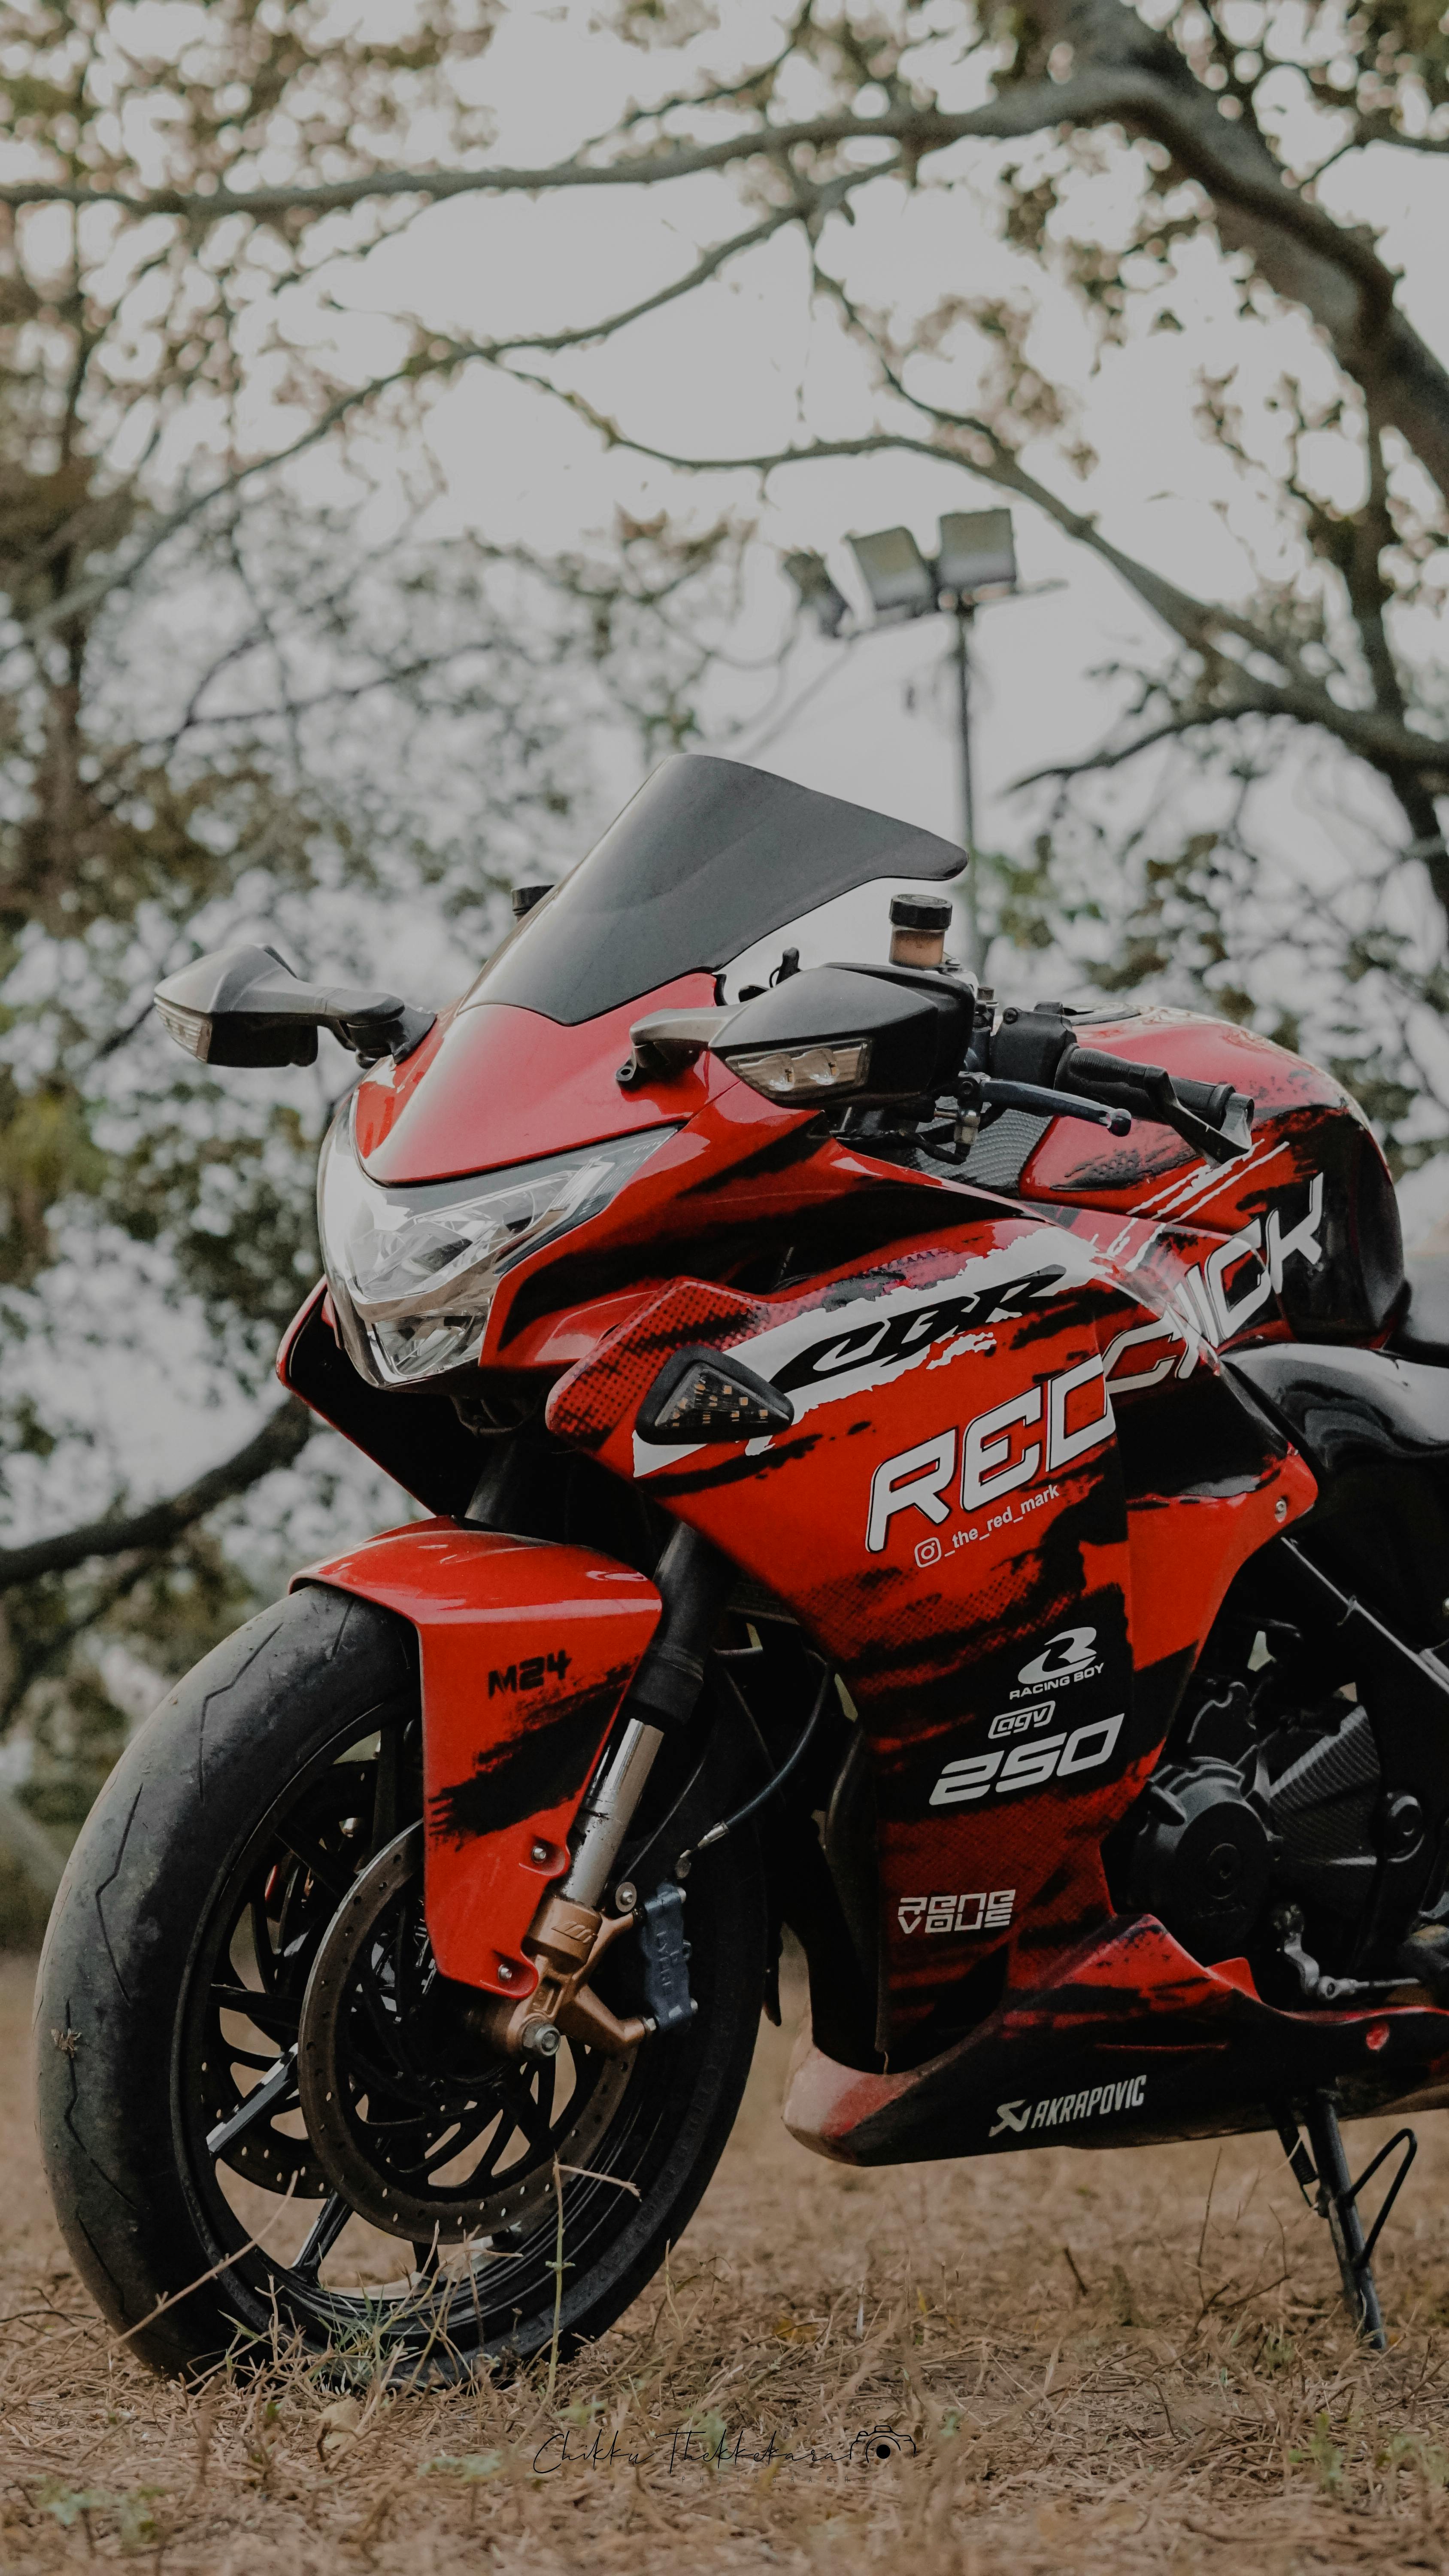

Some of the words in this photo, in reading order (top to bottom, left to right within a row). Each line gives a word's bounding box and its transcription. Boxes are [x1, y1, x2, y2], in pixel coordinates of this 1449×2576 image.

[768, 1264, 1067, 1394] CBR
[488, 1649, 572, 1700] M24
[1009, 1676, 1070, 1700] RACING
[1074, 1662, 1104, 1683] BOY
[929, 1713, 1125, 1805] 250
[1031, 2075, 1147, 2129] AKRAPOVIC
